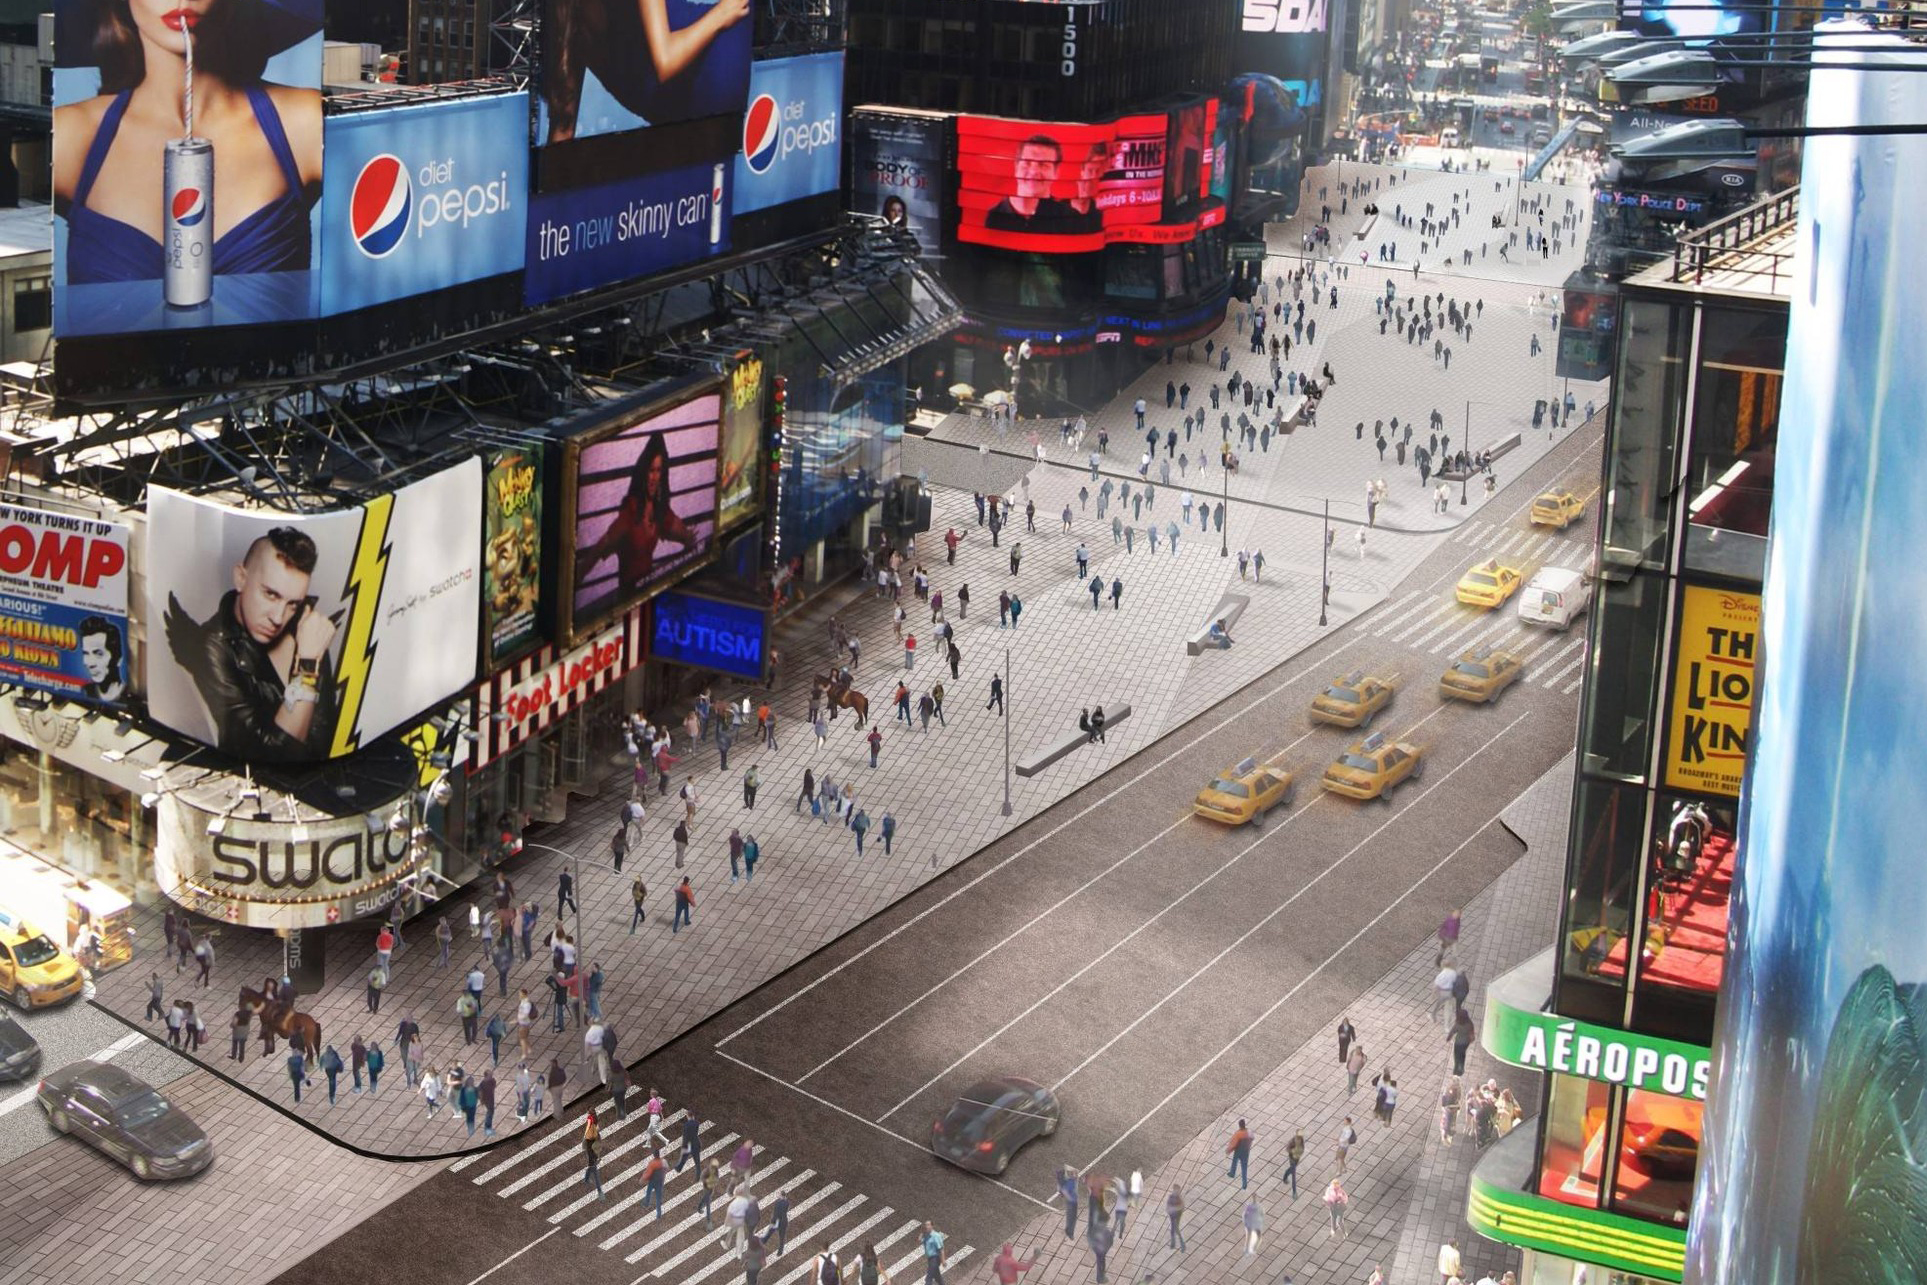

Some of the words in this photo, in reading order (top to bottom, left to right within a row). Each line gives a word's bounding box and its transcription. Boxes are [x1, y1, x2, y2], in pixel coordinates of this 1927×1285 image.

[1061, 6, 1077, 76] 1500
[781, 111, 836, 160] pepsi
[419, 158, 455, 187] diet
[869, 171, 929, 189] PROOF
[417, 170, 510, 239] pepsi
[539, 220, 570, 261] the
[574, 215, 614, 252] new
[617, 199, 674, 241] skinny
[677, 192, 706, 227] can
[1640, 195, 1673, 210] POLICE
[1675, 198, 1702, 212] DEPT
[13, 510, 42, 525] YORK
[45, 515, 79, 532] TURNS
[83, 521, 93, 534] IT
[96, 524, 112, 536] UP
[0, 524, 125, 589] OMP
[656, 618, 760, 662] AUTISM
[506, 672, 552, 731] Foot
[559, 635, 624, 697] Locker
[1688, 661, 1751, 710] LIO
[1681, 714, 1749, 764] KIN
[355, 883, 403, 916] swatch
[1519, 1021, 1711, 1099] AÉROPOS
